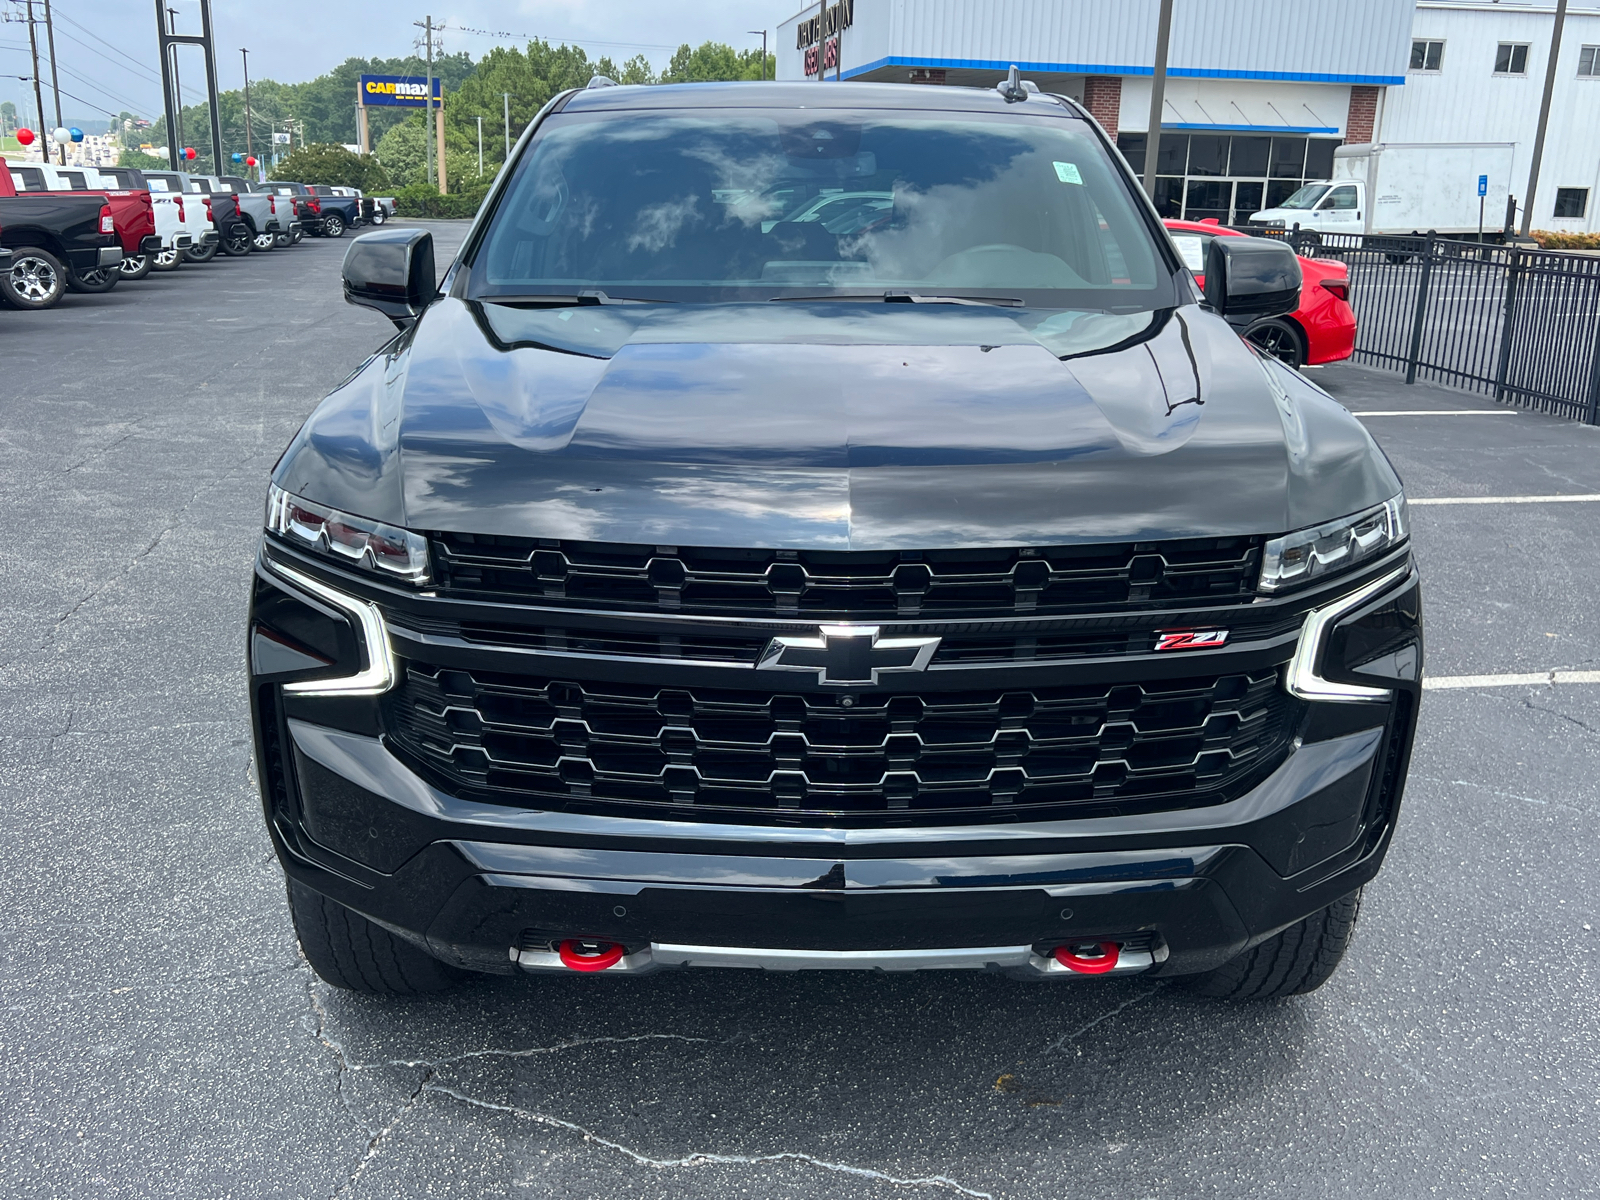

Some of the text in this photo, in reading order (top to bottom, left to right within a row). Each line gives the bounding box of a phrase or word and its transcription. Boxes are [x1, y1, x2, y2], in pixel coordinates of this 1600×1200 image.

[812, 0, 853, 42] THRNTN
[804, 37, 837, 76] USED ARS
[1154, 630, 1230, 651] Z71
